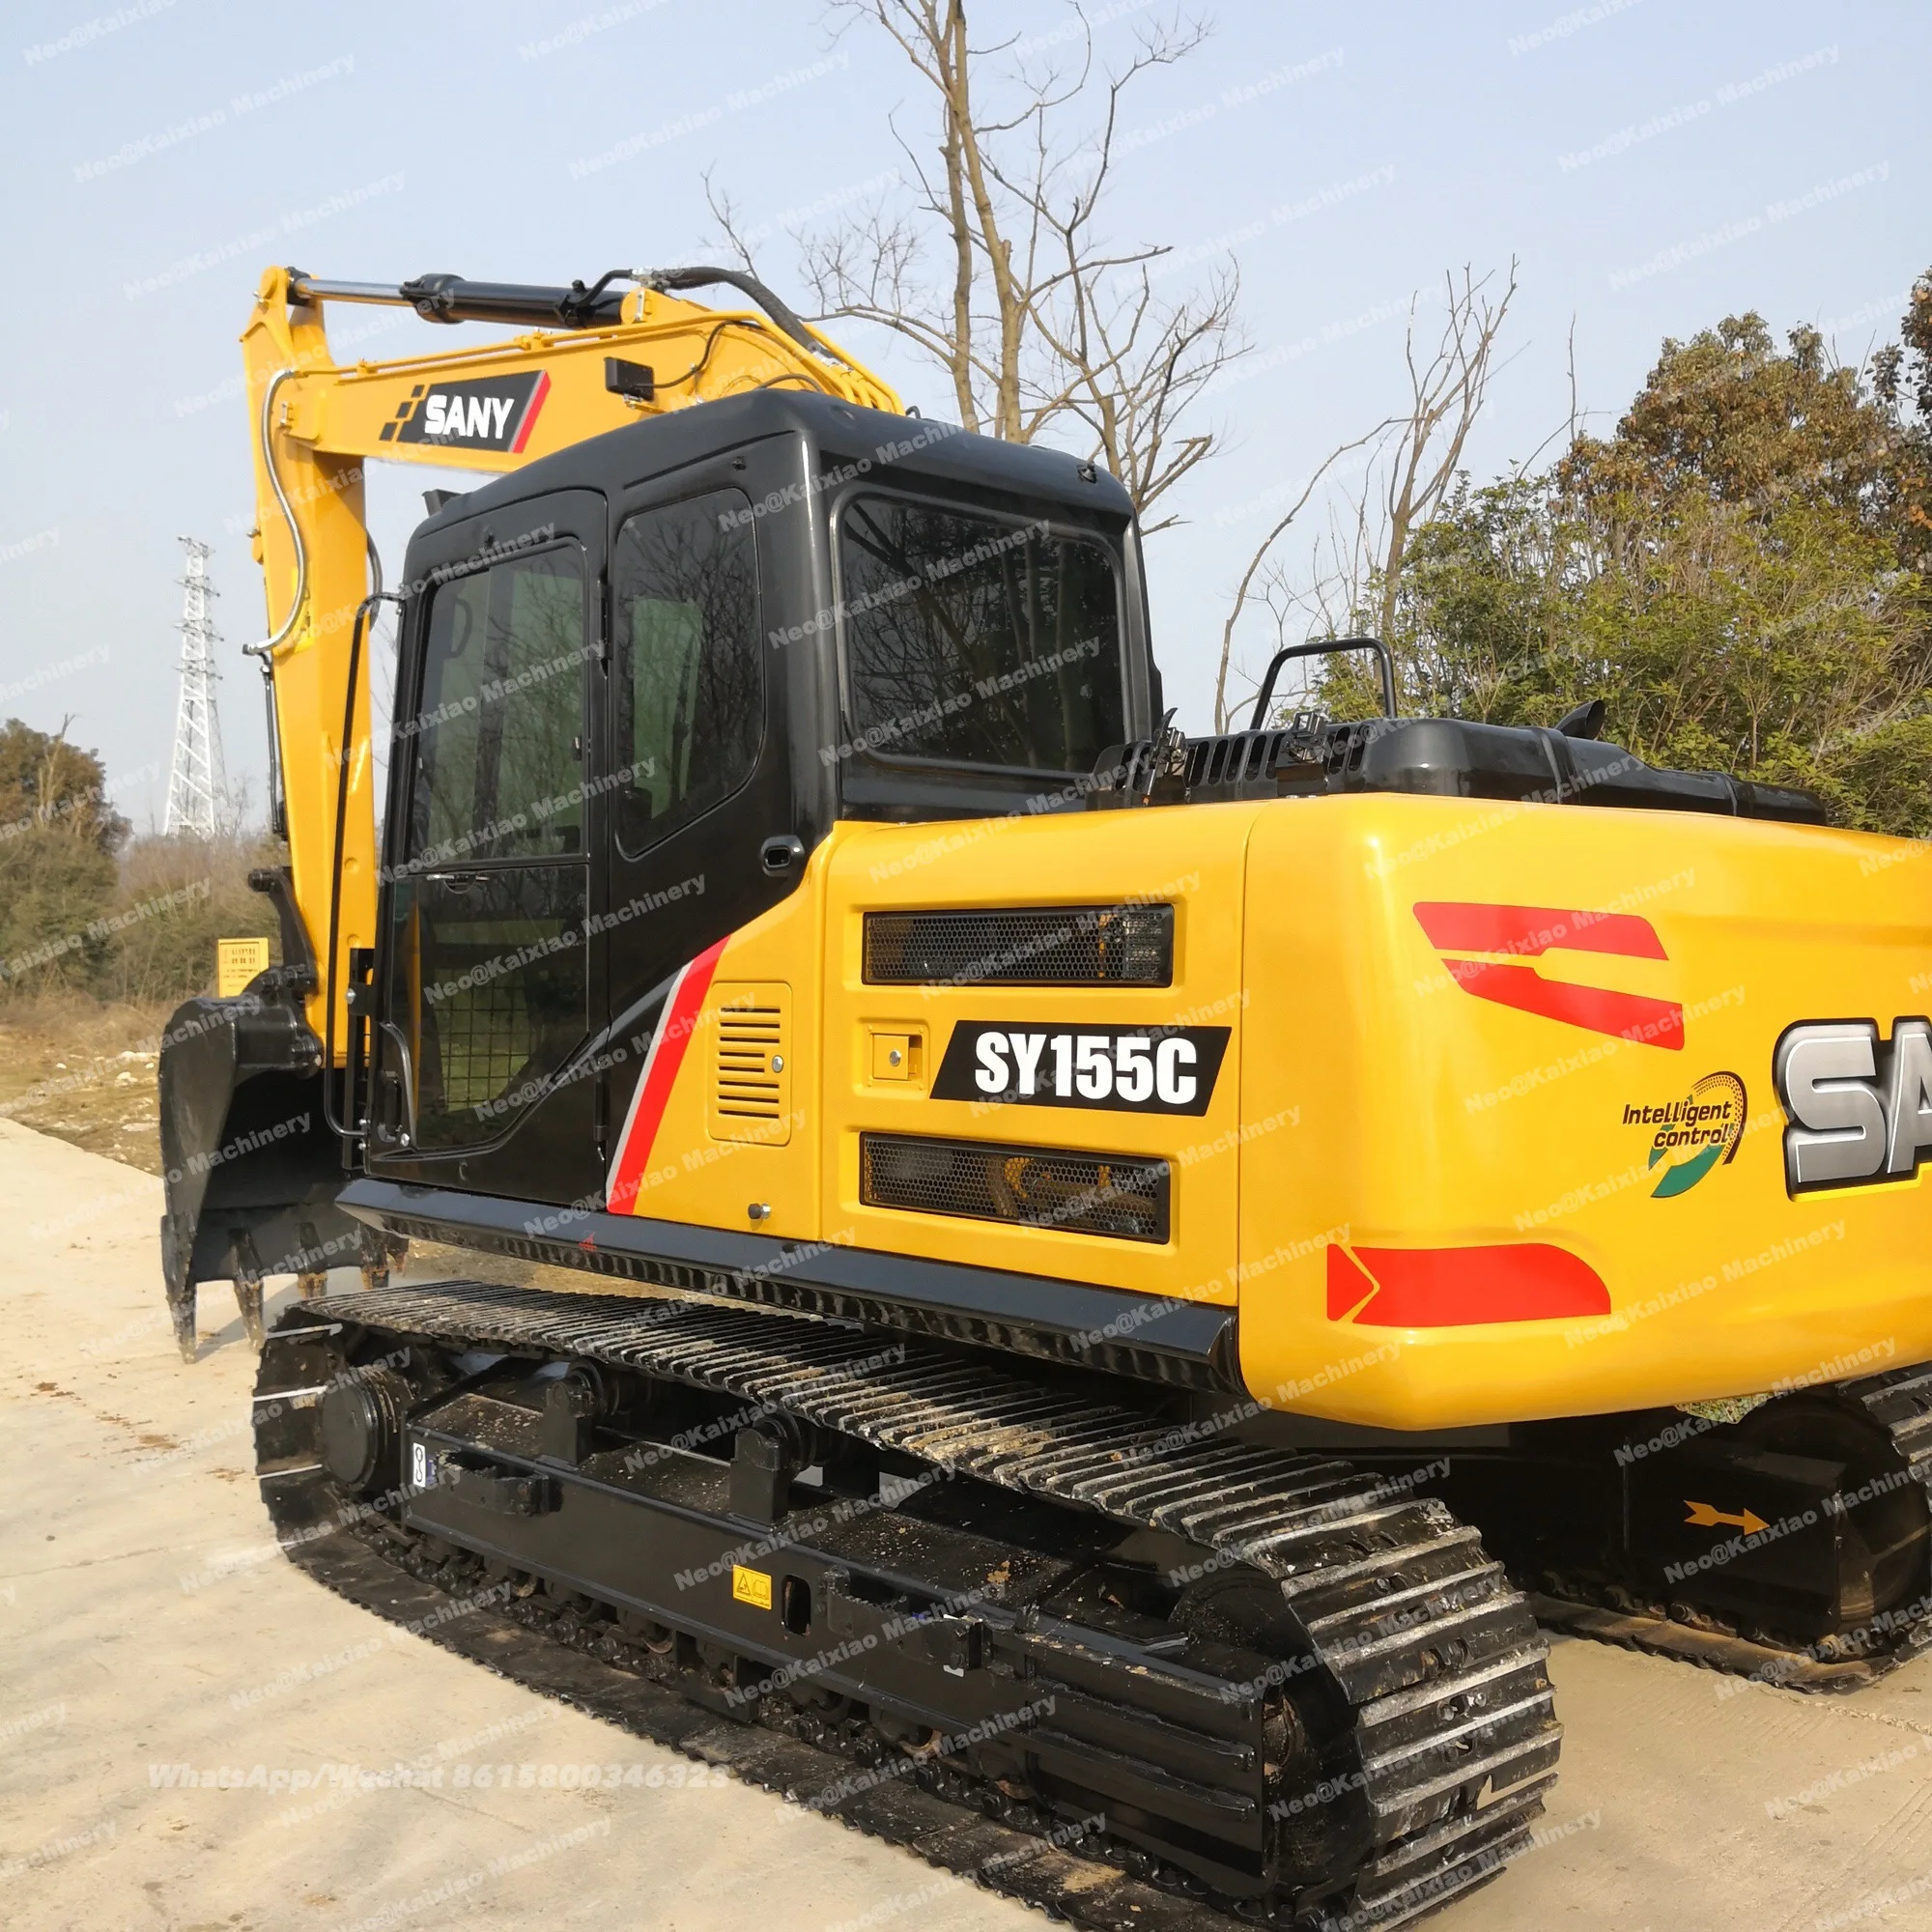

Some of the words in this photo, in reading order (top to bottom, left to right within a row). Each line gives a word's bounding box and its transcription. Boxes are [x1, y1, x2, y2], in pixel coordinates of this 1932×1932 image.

[425, 394, 515, 440] SANY
[975, 1031, 1197, 1104] SY155C
[1622, 1100, 1732, 1127] Intelligent
[1653, 1122, 1729, 1148] control
